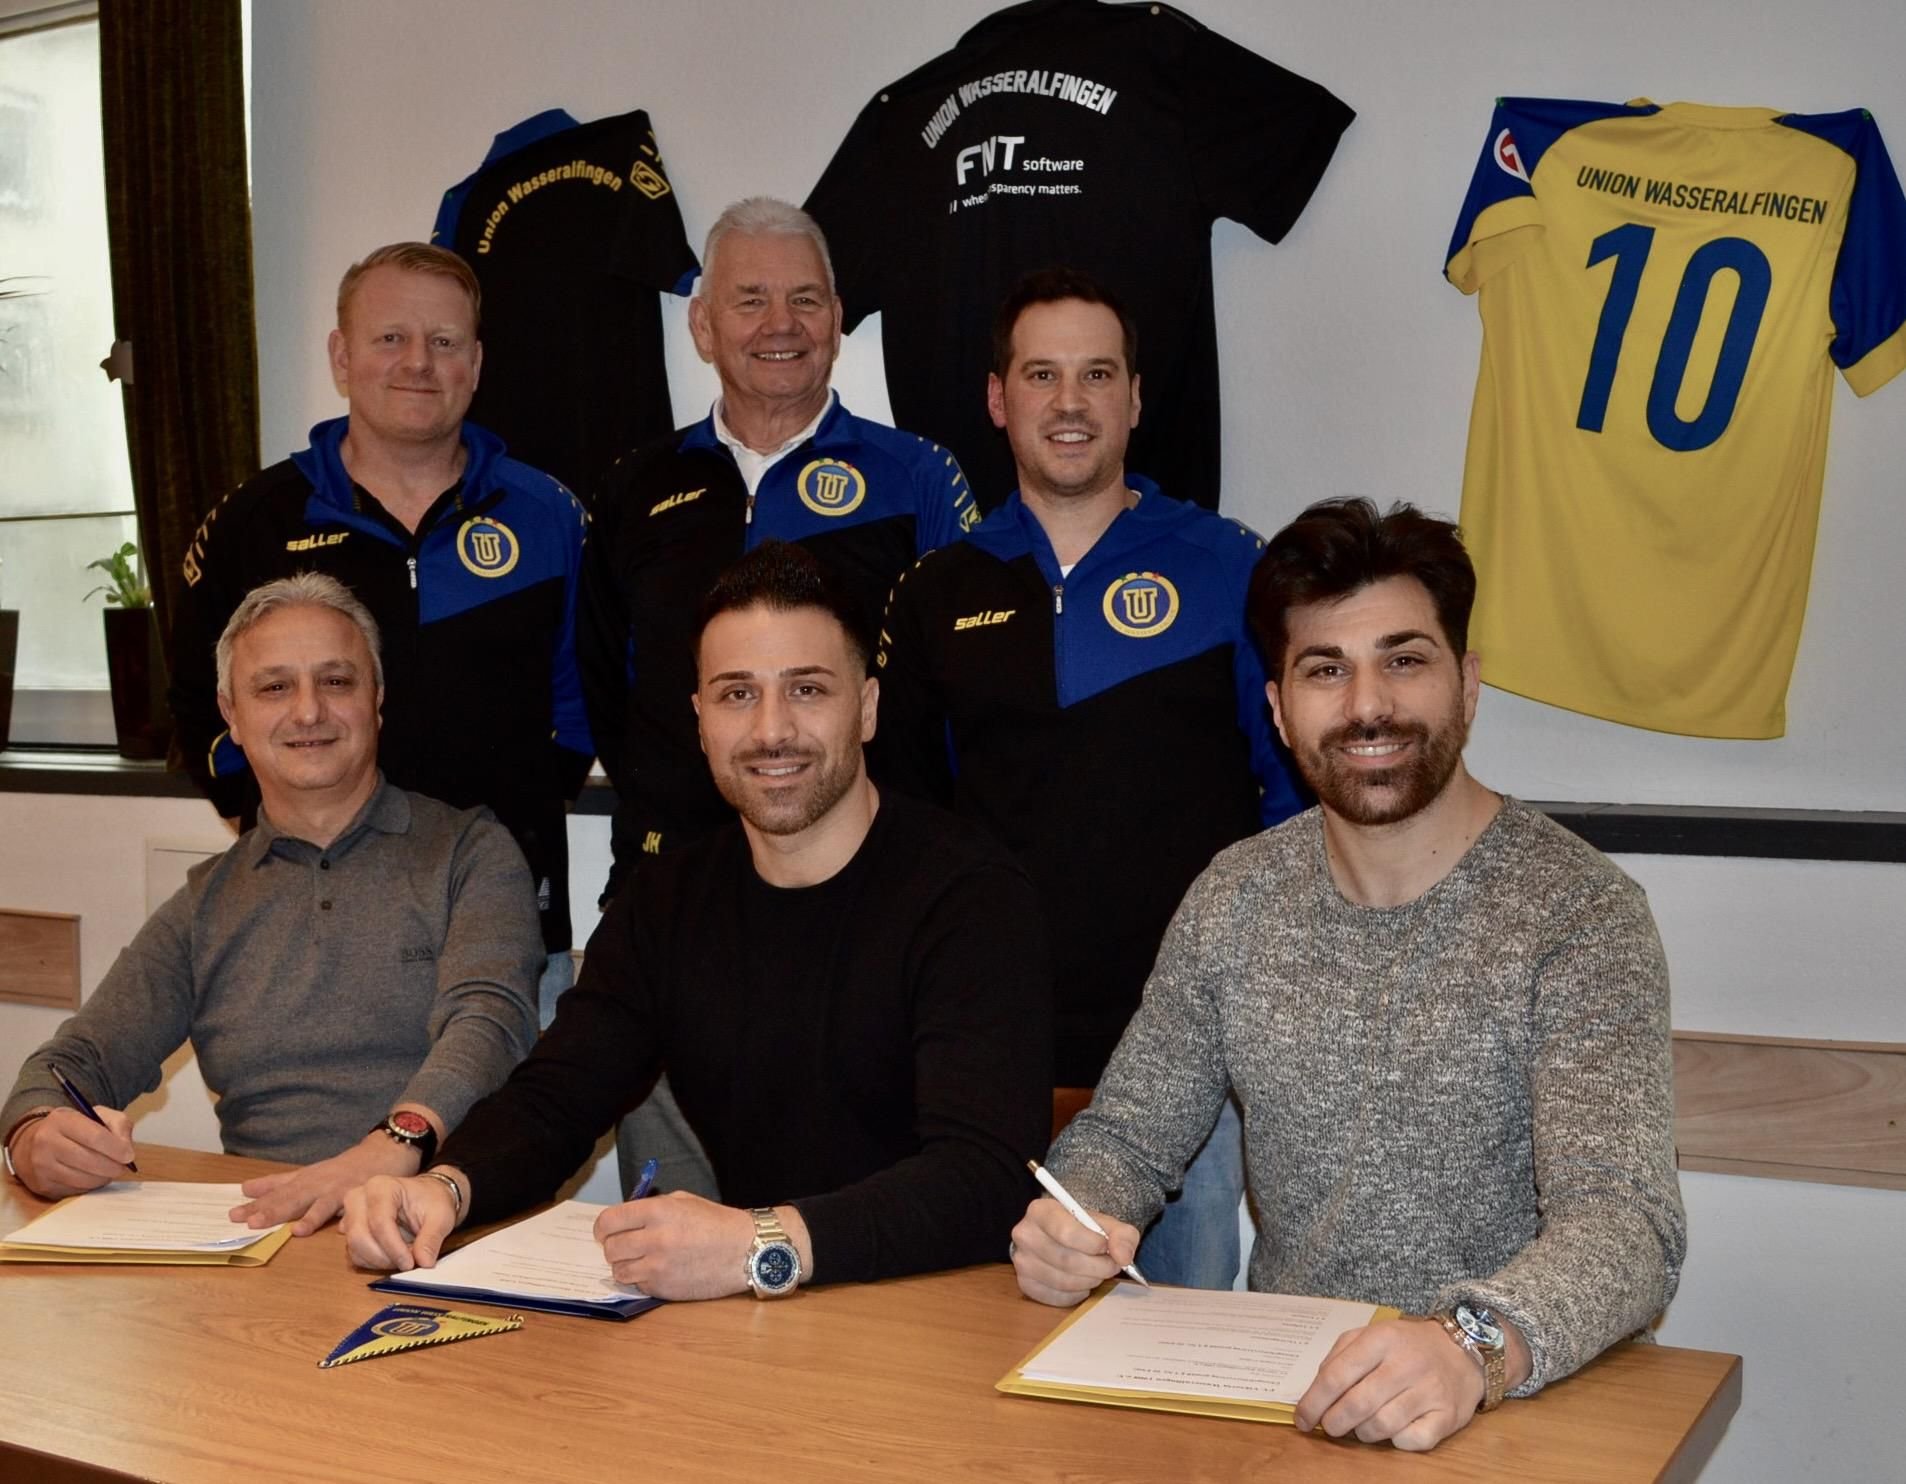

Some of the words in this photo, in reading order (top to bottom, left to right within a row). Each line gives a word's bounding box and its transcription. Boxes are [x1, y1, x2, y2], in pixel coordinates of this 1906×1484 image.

[921, 94, 961, 149] UNION
[958, 70, 1117, 115] WASSERALFINGEN
[507, 159, 623, 204] Wasseralfingen
[1022, 157, 1084, 172] software
[1038, 184, 1083, 195] matters.
[1576, 165, 1641, 199] UNION
[1644, 179, 1828, 225] WASSERALFINGEN
[1576, 222, 1772, 452] 10
[816, 471, 850, 505] U
[286, 532, 350, 551] saller
[471, 532, 502, 565] U
[954, 610, 1015, 631] saller
[1122, 587, 1158, 624] U
